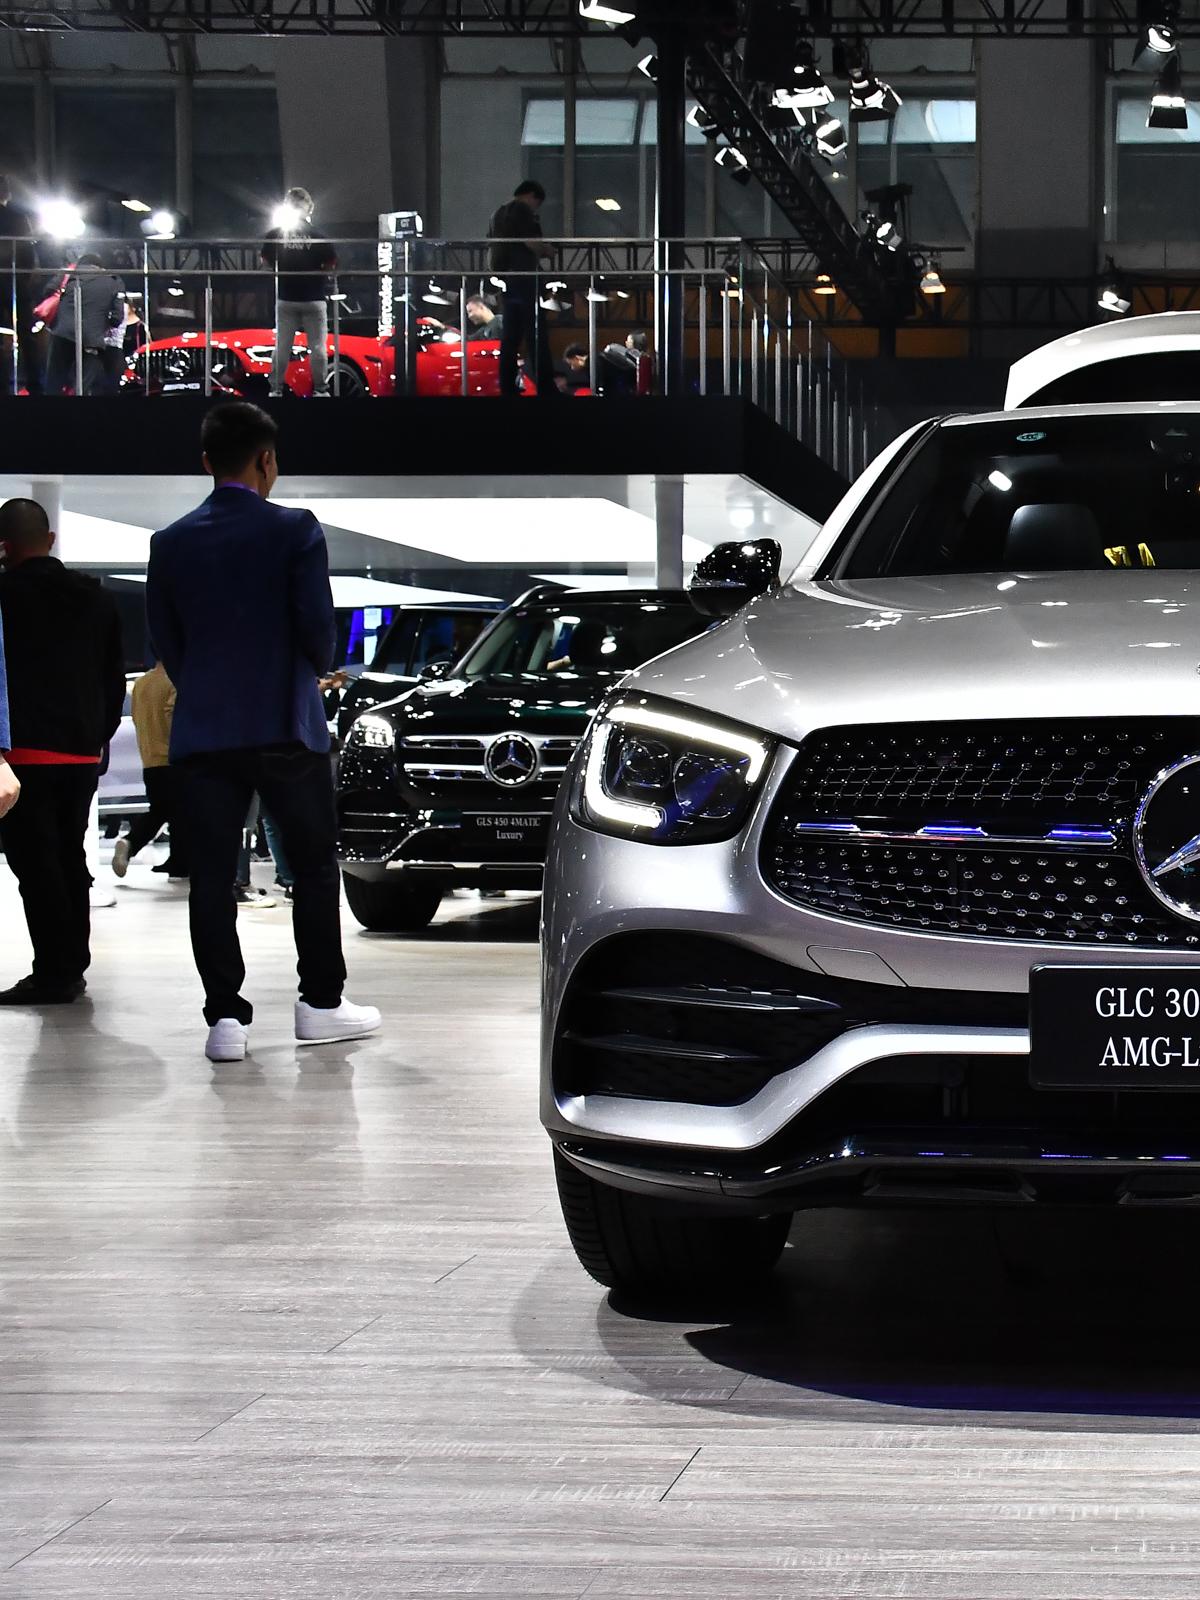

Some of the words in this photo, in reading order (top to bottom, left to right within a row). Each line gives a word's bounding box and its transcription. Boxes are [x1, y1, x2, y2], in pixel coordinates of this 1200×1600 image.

[378, 241, 393, 273] AMG
[476, 817, 492, 827] GLS
[494, 817, 509, 827] 450
[510, 817, 541, 827] 4MATIC
[496, 830, 523, 841] Luxury
[1095, 987, 1154, 1018] GLC
